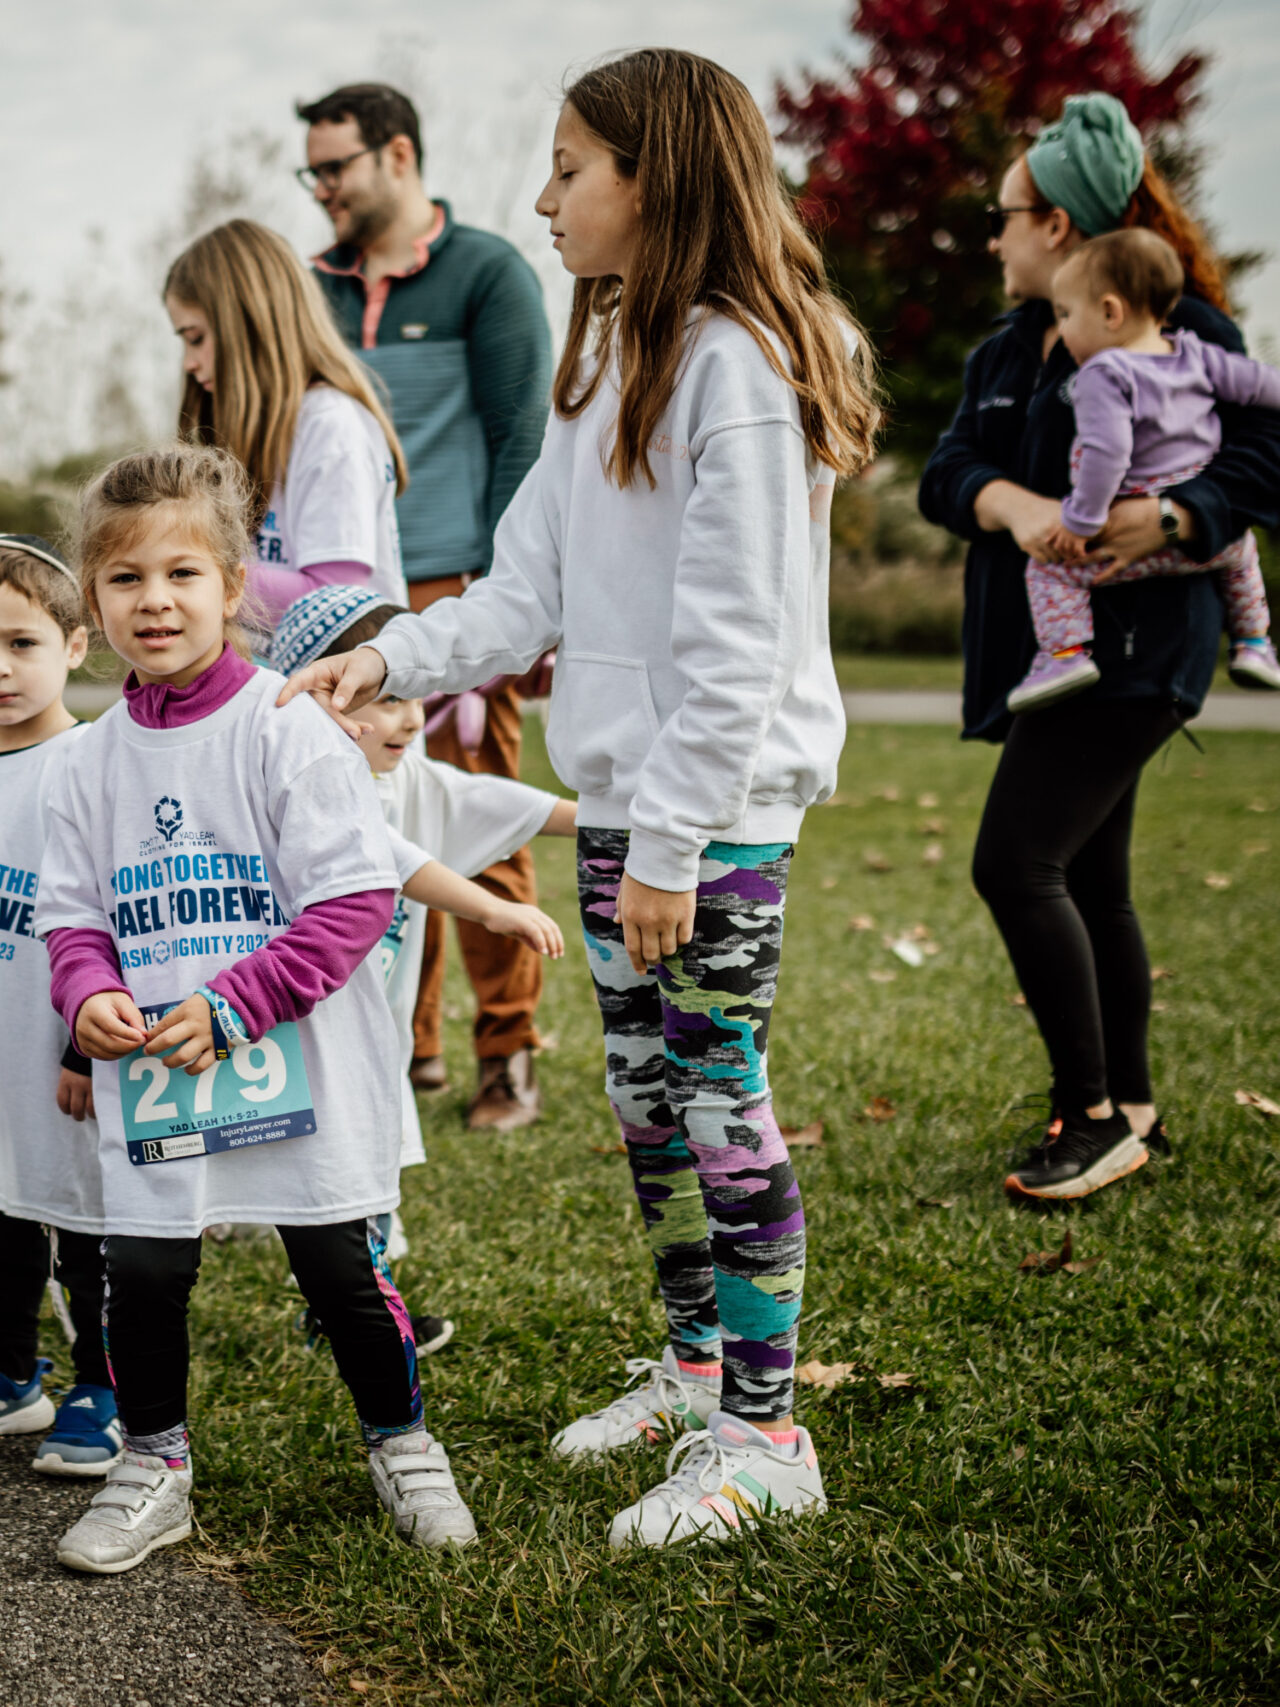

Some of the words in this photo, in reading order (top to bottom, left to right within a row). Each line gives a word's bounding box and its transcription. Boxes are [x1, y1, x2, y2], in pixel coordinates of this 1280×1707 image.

[121, 946, 152, 970] ASH
[128, 1036, 288, 1124] 279
[169, 1122, 189, 1133] YAD
[191, 1117, 219, 1130] LEAH
[220, 1117, 292, 1138] InjuryLawyer.com
[229, 1129, 287, 1148] 800-624-8888
